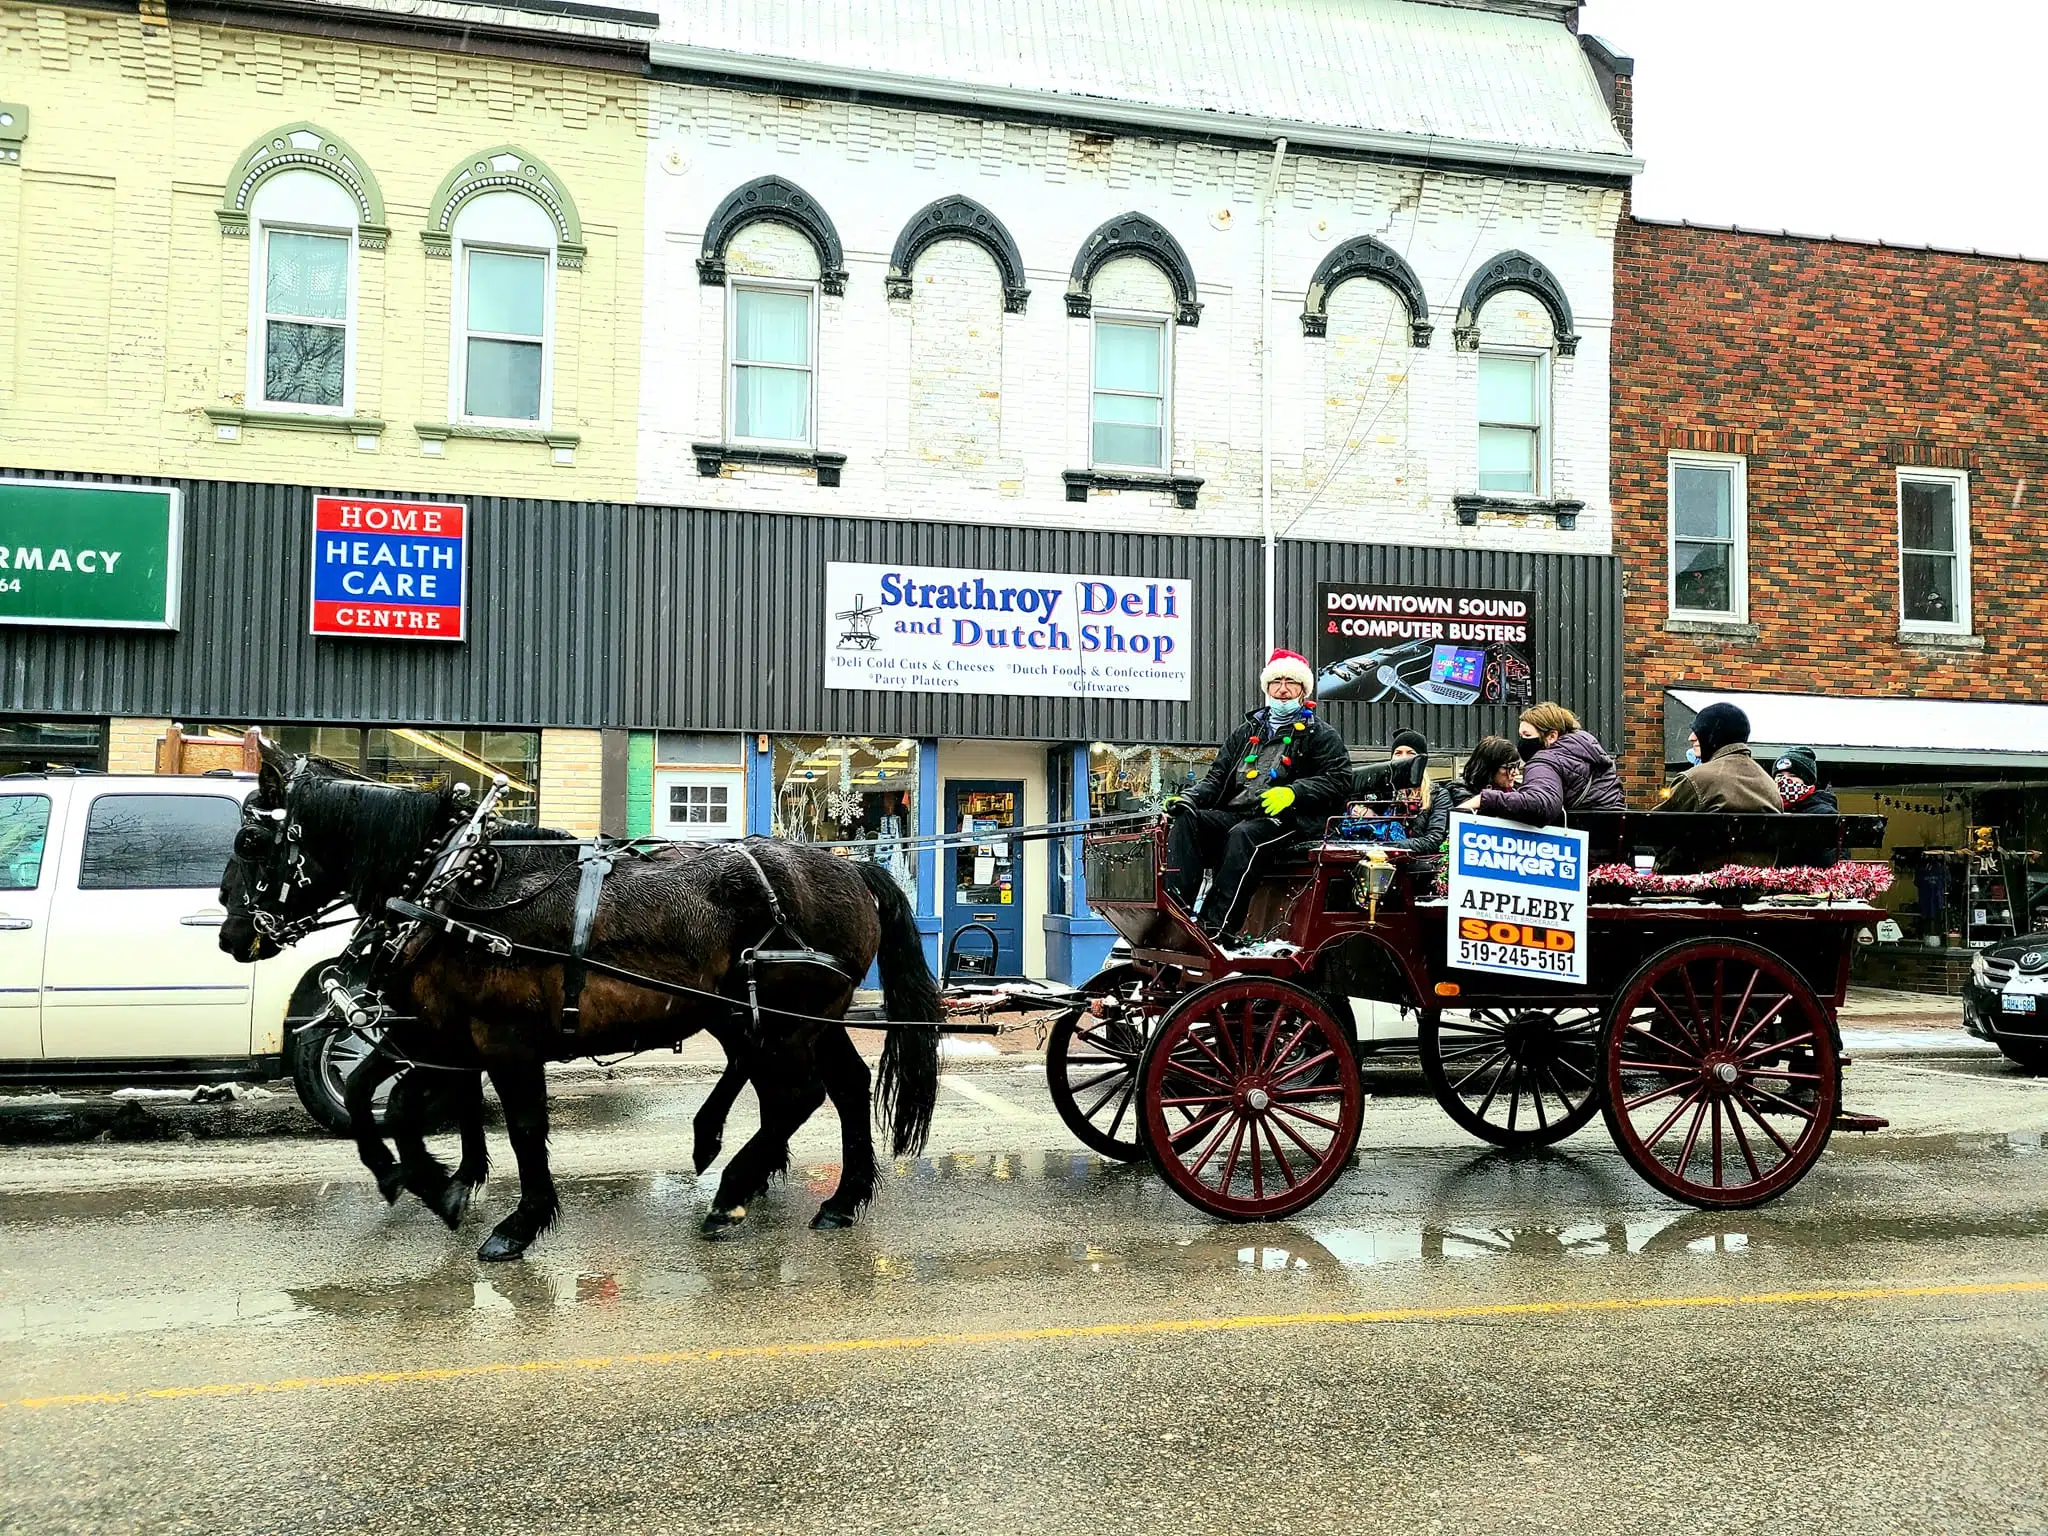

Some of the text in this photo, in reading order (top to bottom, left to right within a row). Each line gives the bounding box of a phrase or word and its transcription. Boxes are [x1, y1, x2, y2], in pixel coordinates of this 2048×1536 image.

[340, 506, 442, 533] HOME
[326, 541, 453, 569] HEALTH
[342, 571, 436, 598] CARE
[881, 573, 1179, 624] Strathroy Deli
[1327, 592, 1527, 617] DOWNTOWN SOUND
[336, 608, 441, 629] CENTRE
[1327, 619, 1527, 642] & COMPUTER BUSTERS
[894, 617, 1175, 664] and Dutch Shop
[867, 657, 895, 669] Cold
[900, 658, 928, 670] Cuts
[932, 659, 943, 671] &
[947, 660, 995, 673] Cheeses
[1052, 664, 1087, 677] Foods
[1090, 666, 1101, 677] &
[1105, 666, 1186, 683] Confectionery
[912, 674, 960, 687] Platters
[1460, 889, 1575, 922] APPLEBY
[1476, 911, 1560, 928] REAL ESTATE BROKERAGE
[1461, 918, 1574, 951] SOLD
[1460, 941, 1574, 973] 519-245-5151
